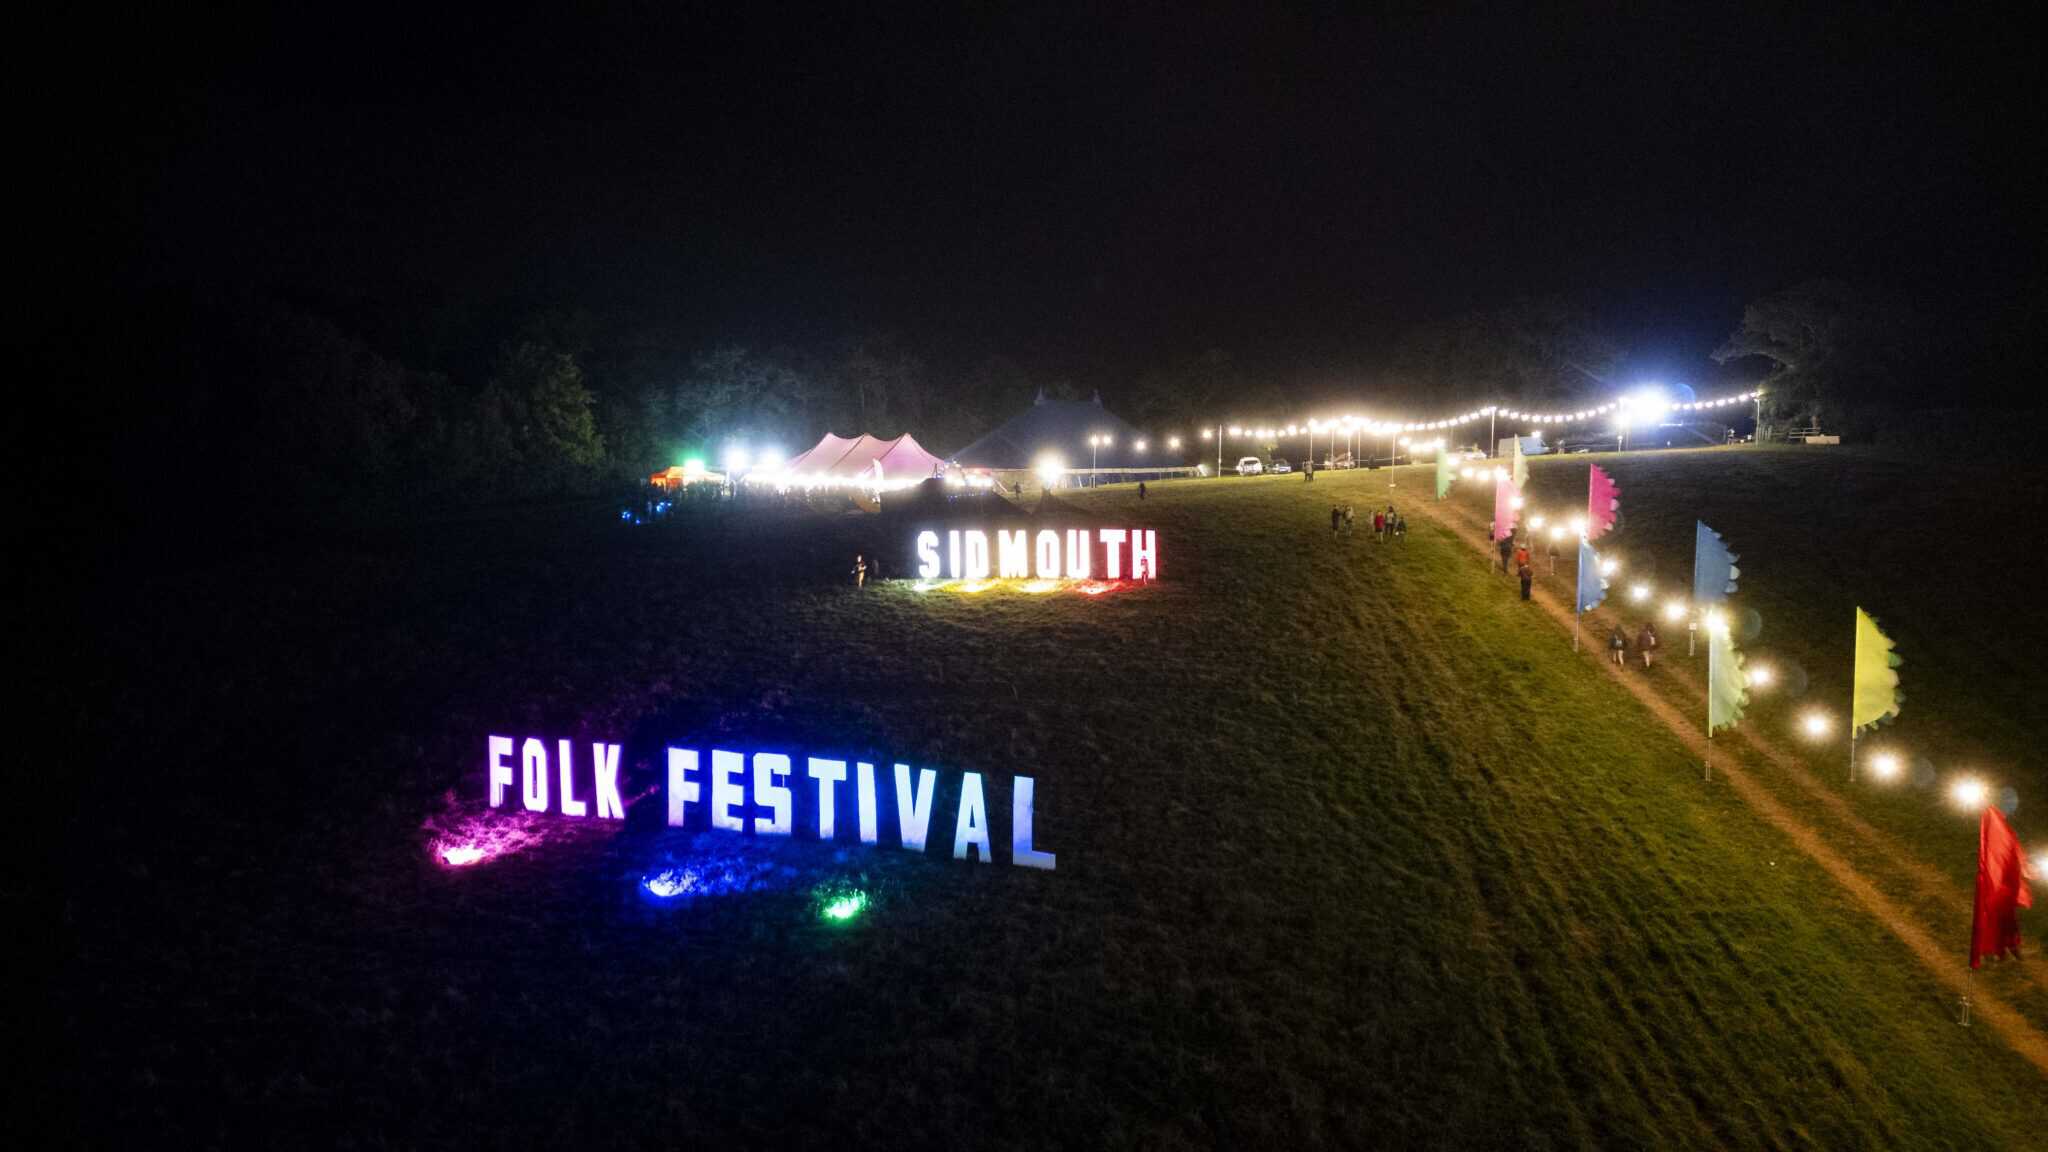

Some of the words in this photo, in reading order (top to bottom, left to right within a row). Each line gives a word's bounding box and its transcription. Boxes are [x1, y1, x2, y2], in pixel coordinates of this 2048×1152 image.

[917, 528, 1156, 580] SIDMOUTH
[489, 735, 626, 819] FOLK
[667, 746, 1056, 870] FESTIVAL
